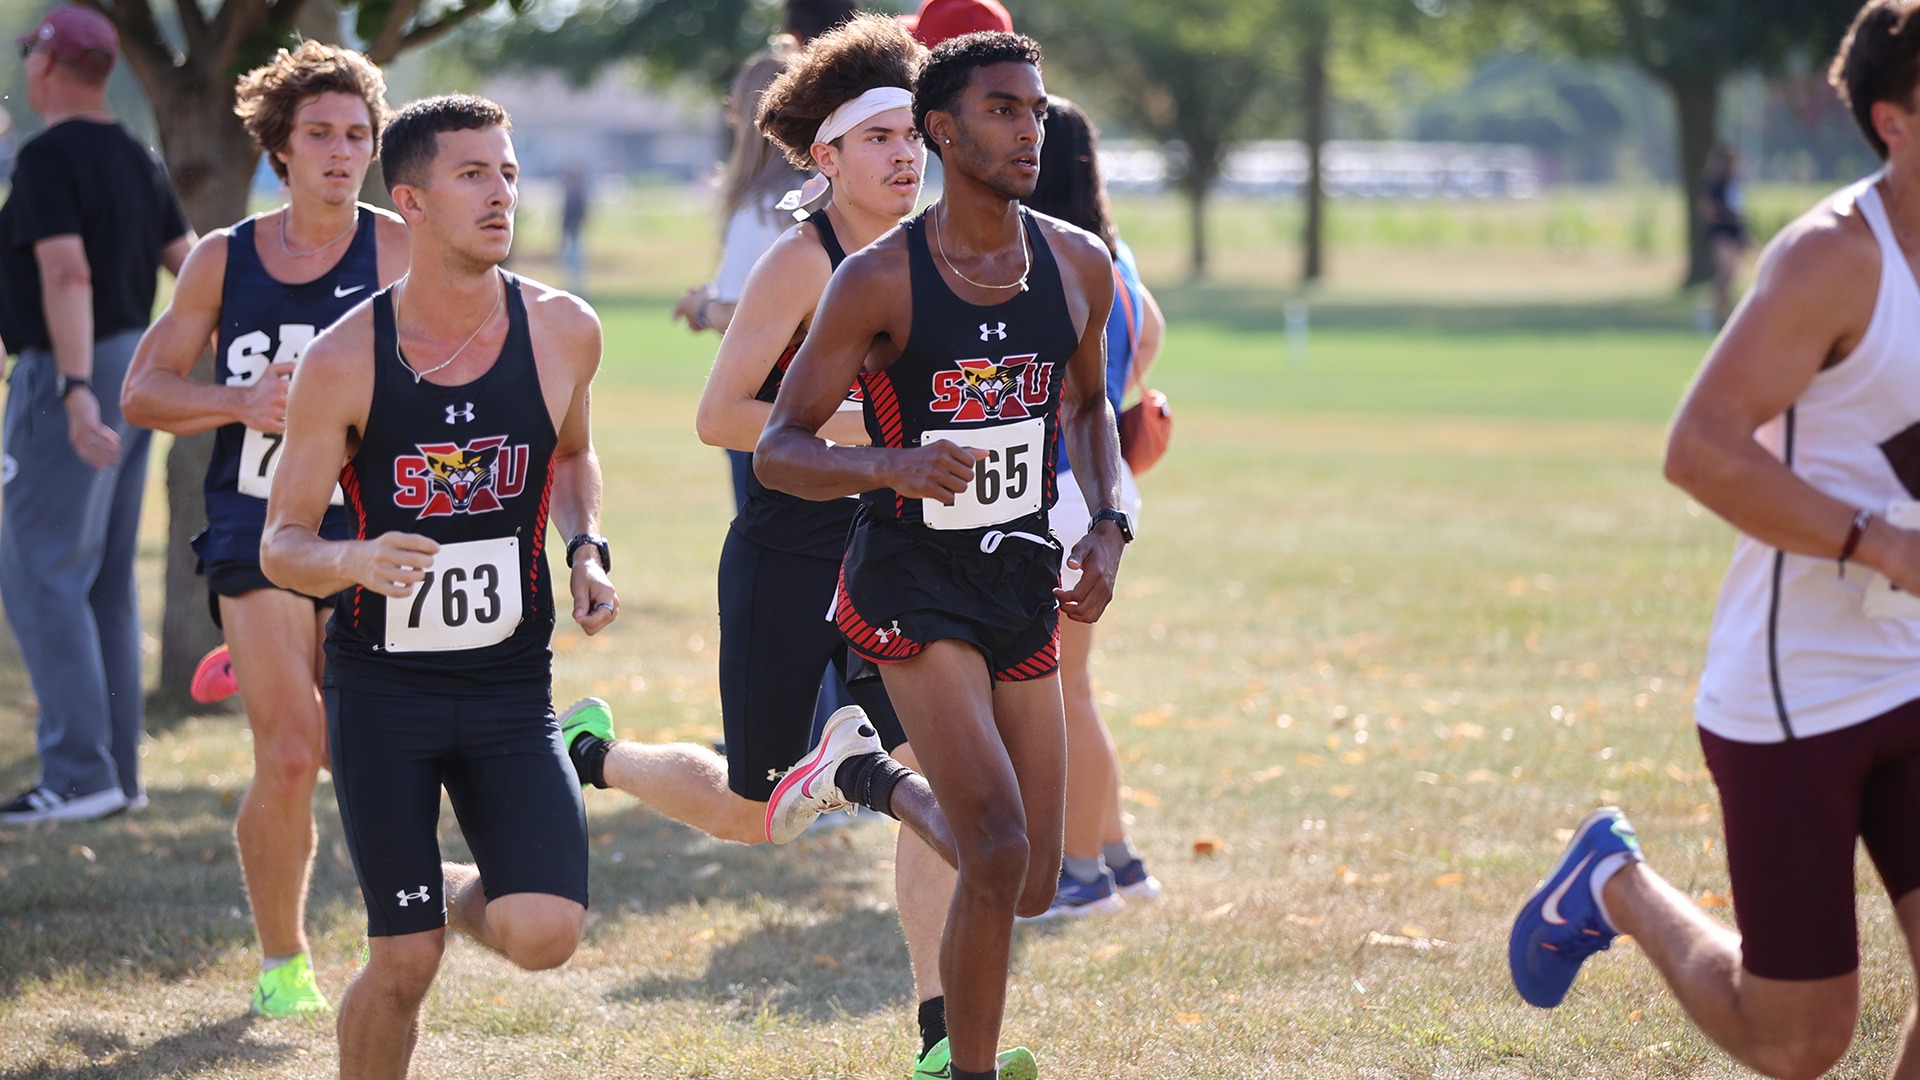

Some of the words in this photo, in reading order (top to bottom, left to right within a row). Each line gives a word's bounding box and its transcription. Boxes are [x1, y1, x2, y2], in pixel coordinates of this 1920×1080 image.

[226, 324, 325, 387] SA
[943, 443, 1029, 507] 65
[407, 563, 502, 629] 763
